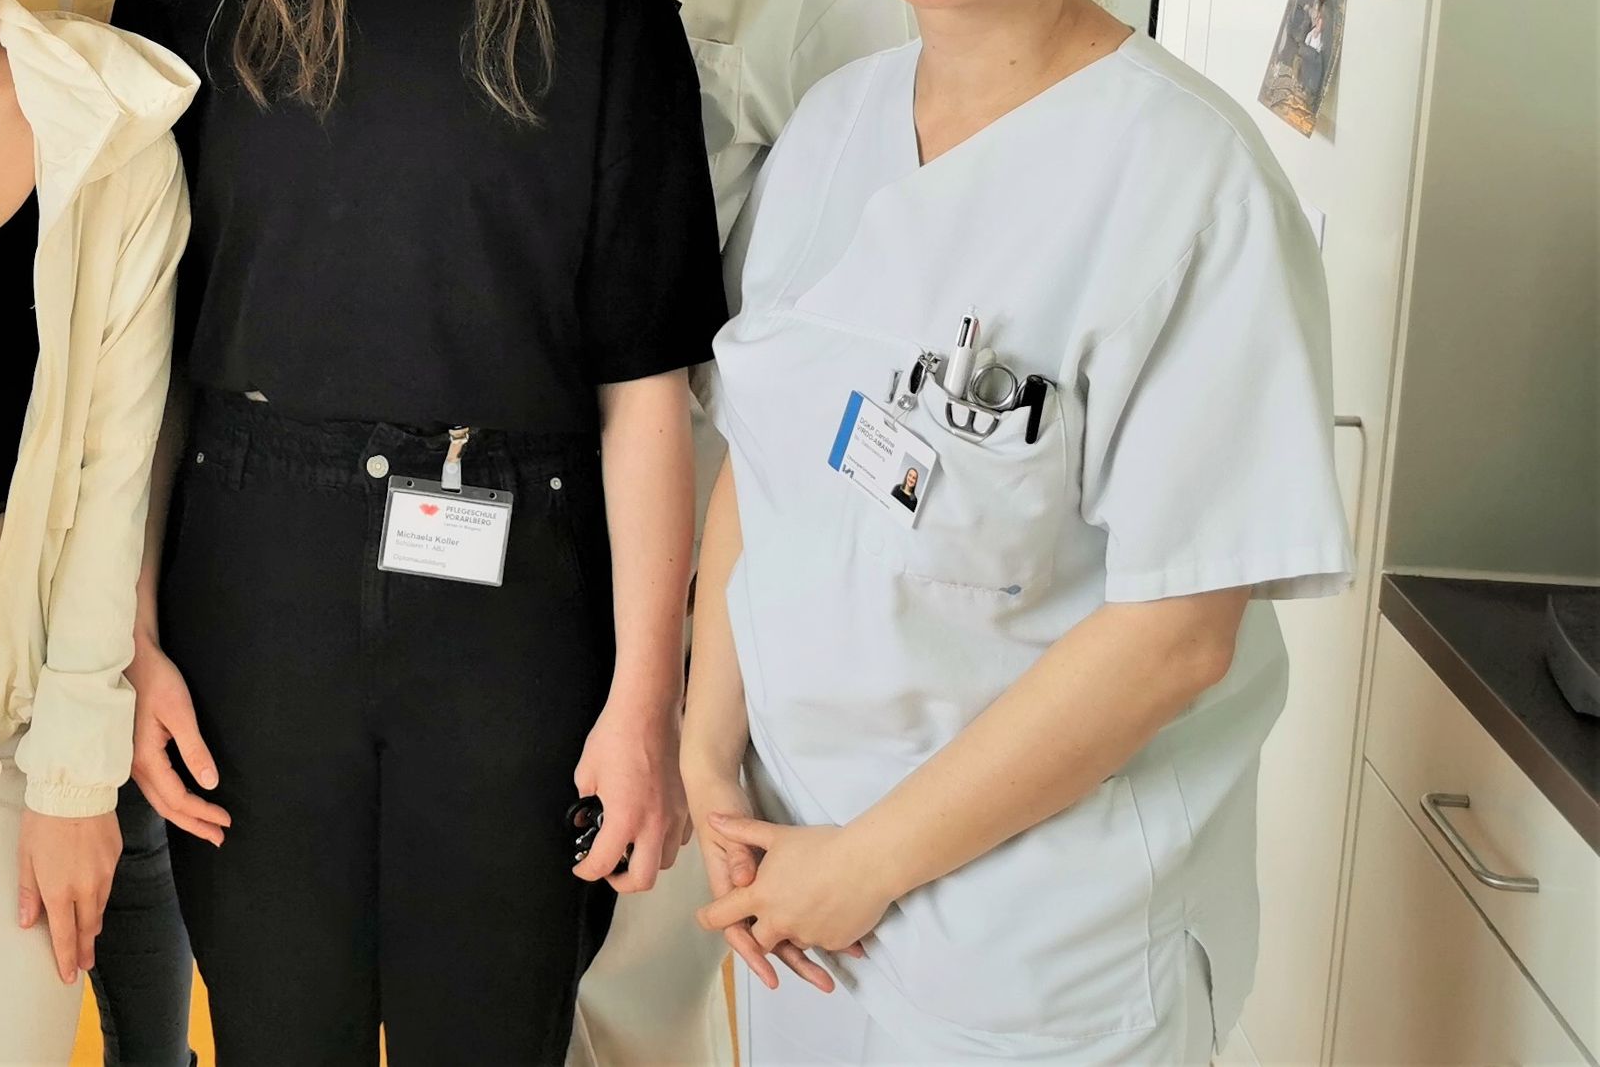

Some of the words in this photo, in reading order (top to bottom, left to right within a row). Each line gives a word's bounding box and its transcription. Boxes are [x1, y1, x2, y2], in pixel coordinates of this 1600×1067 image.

[446, 506, 497, 519] PFLEGESCHULE
[445, 514, 492, 526] VORARLBERG
[396, 530, 433, 542] Michaela
[435, 536, 460, 546] Koller
